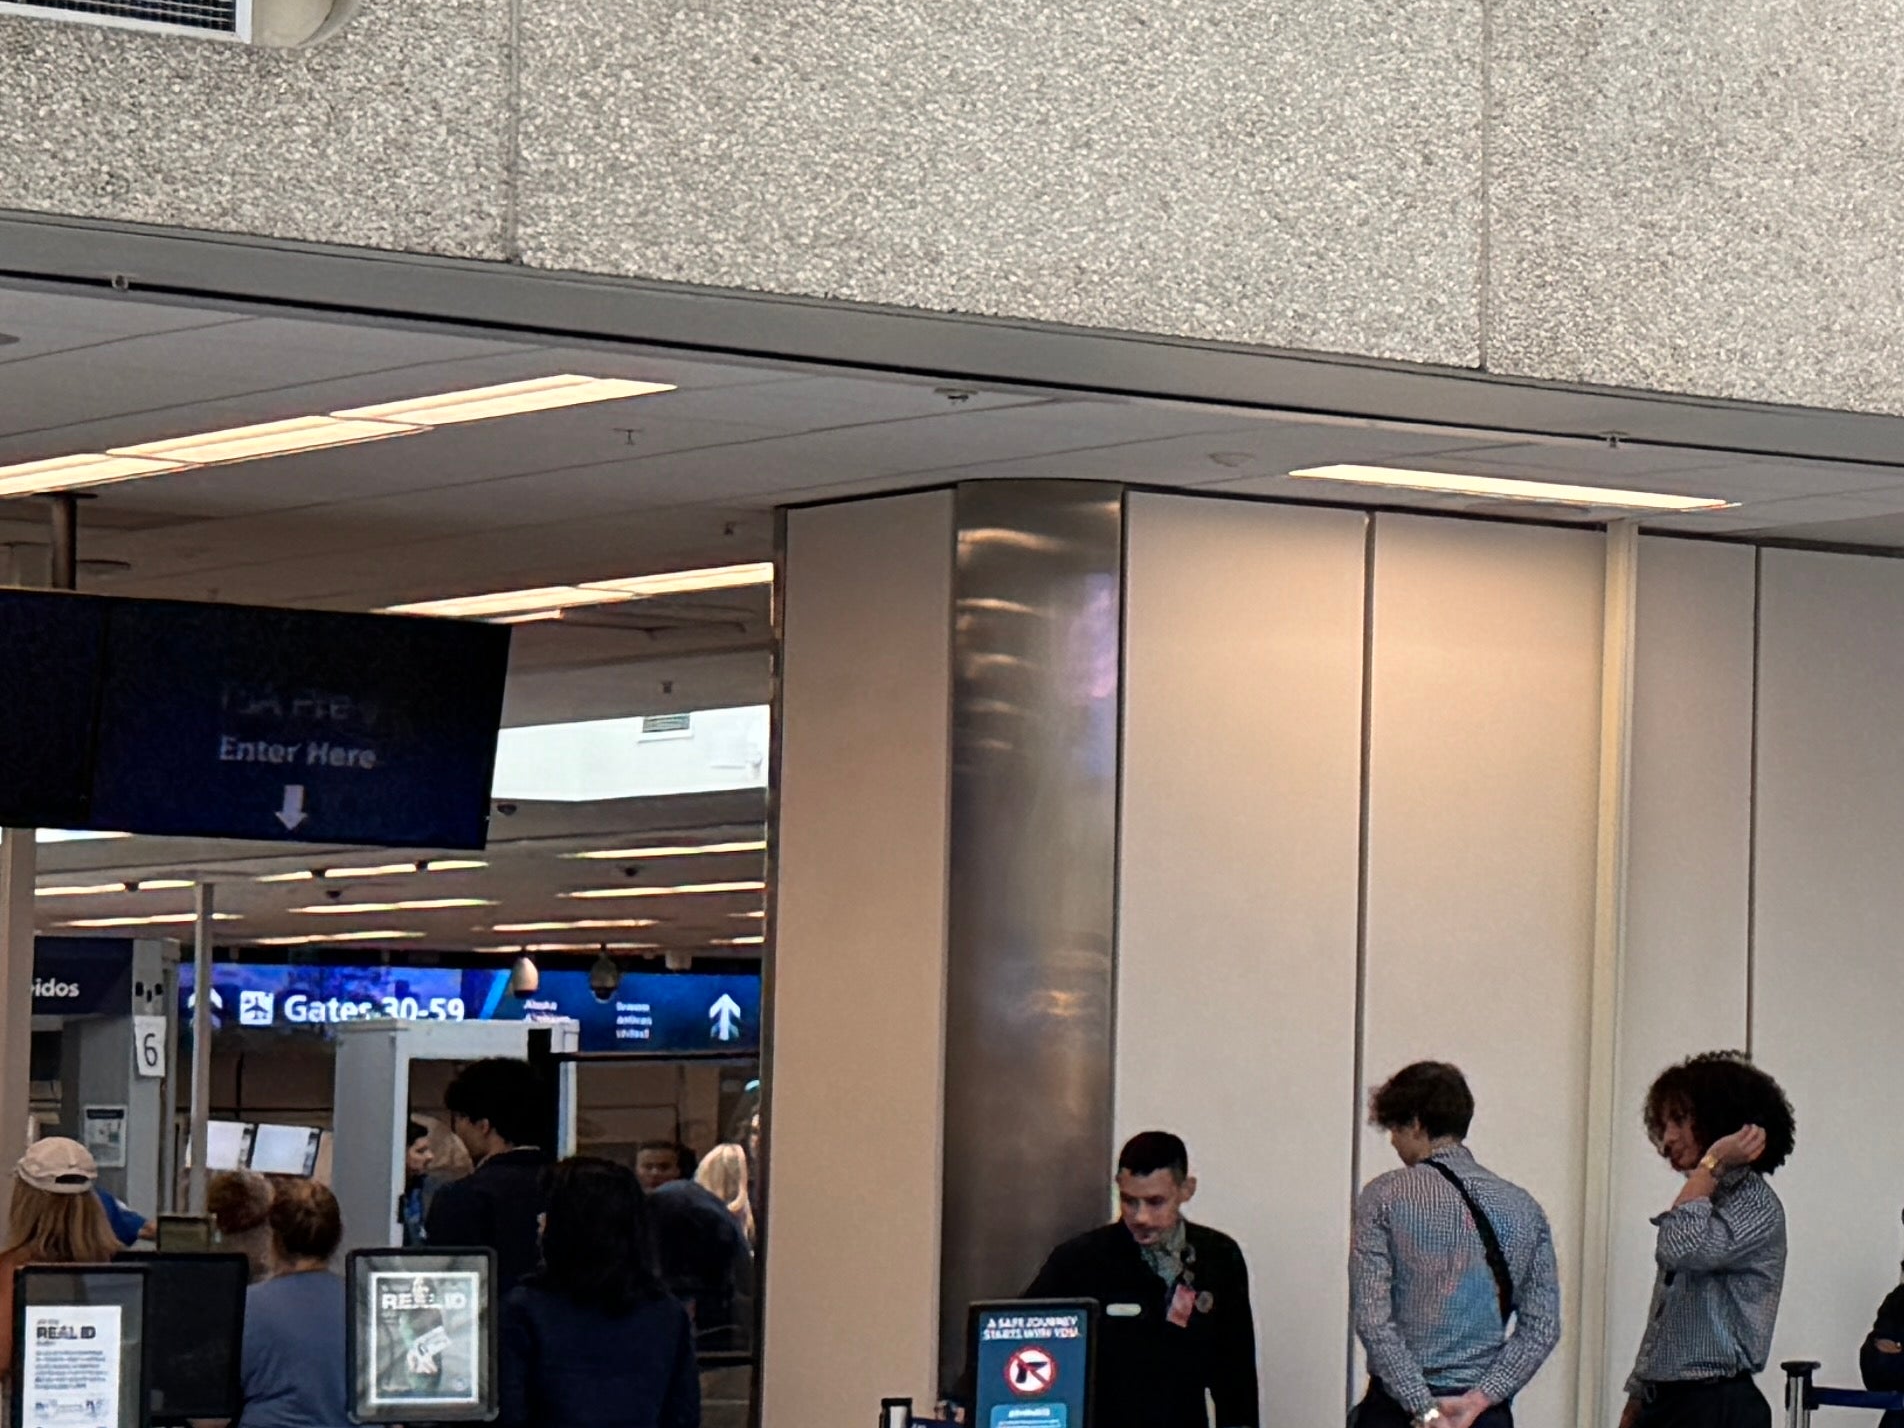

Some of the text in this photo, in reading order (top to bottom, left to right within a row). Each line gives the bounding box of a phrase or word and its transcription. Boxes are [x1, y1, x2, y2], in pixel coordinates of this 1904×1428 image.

[218, 734, 377, 769] Enter Here
[284, 994, 373, 1023] Gates
[143, 1033, 159, 1067] 6
